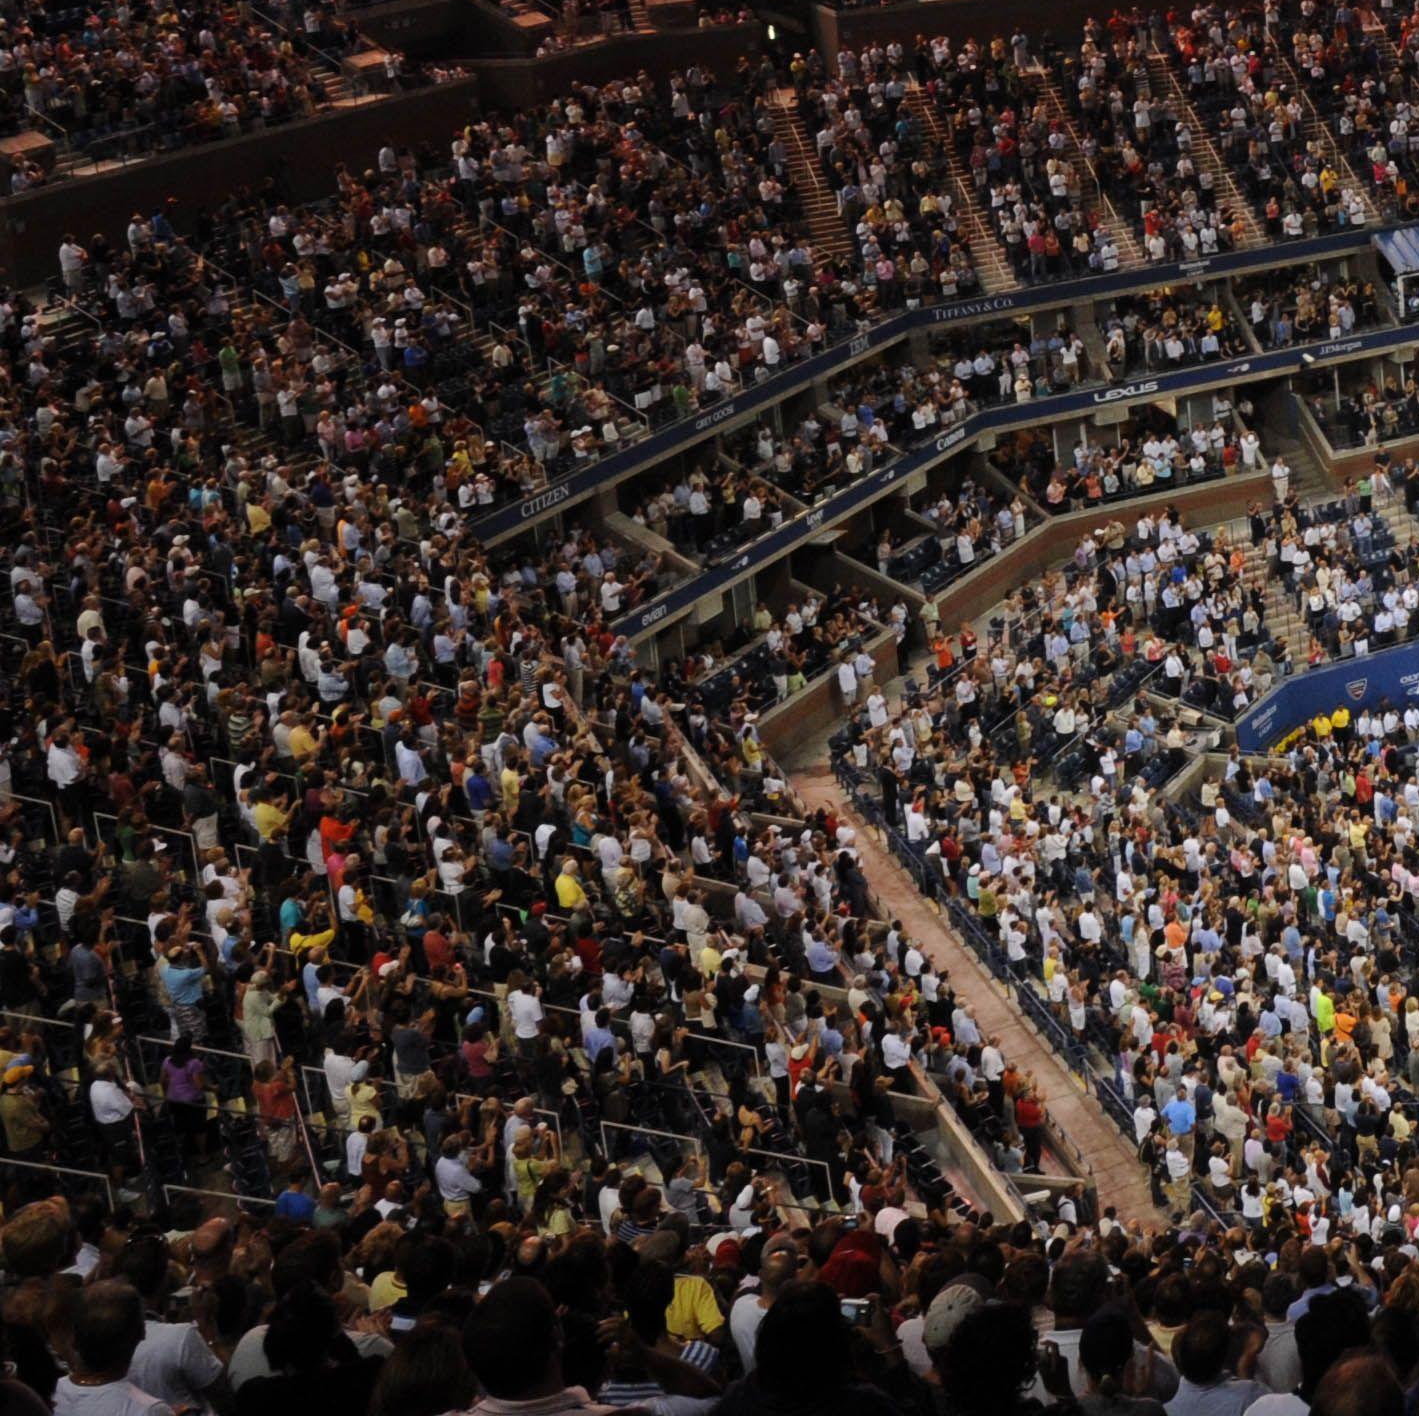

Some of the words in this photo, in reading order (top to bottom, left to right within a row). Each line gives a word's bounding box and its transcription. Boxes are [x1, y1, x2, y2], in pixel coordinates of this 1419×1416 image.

[932, 304, 983, 320] TIFFANY
[849, 336, 871, 357] IBM
[1093, 381, 1159, 403] LEXUS
[936, 427, 966, 451] Canon
[521, 483, 570, 518] CITIZEN
[641, 604, 668, 627] evian
